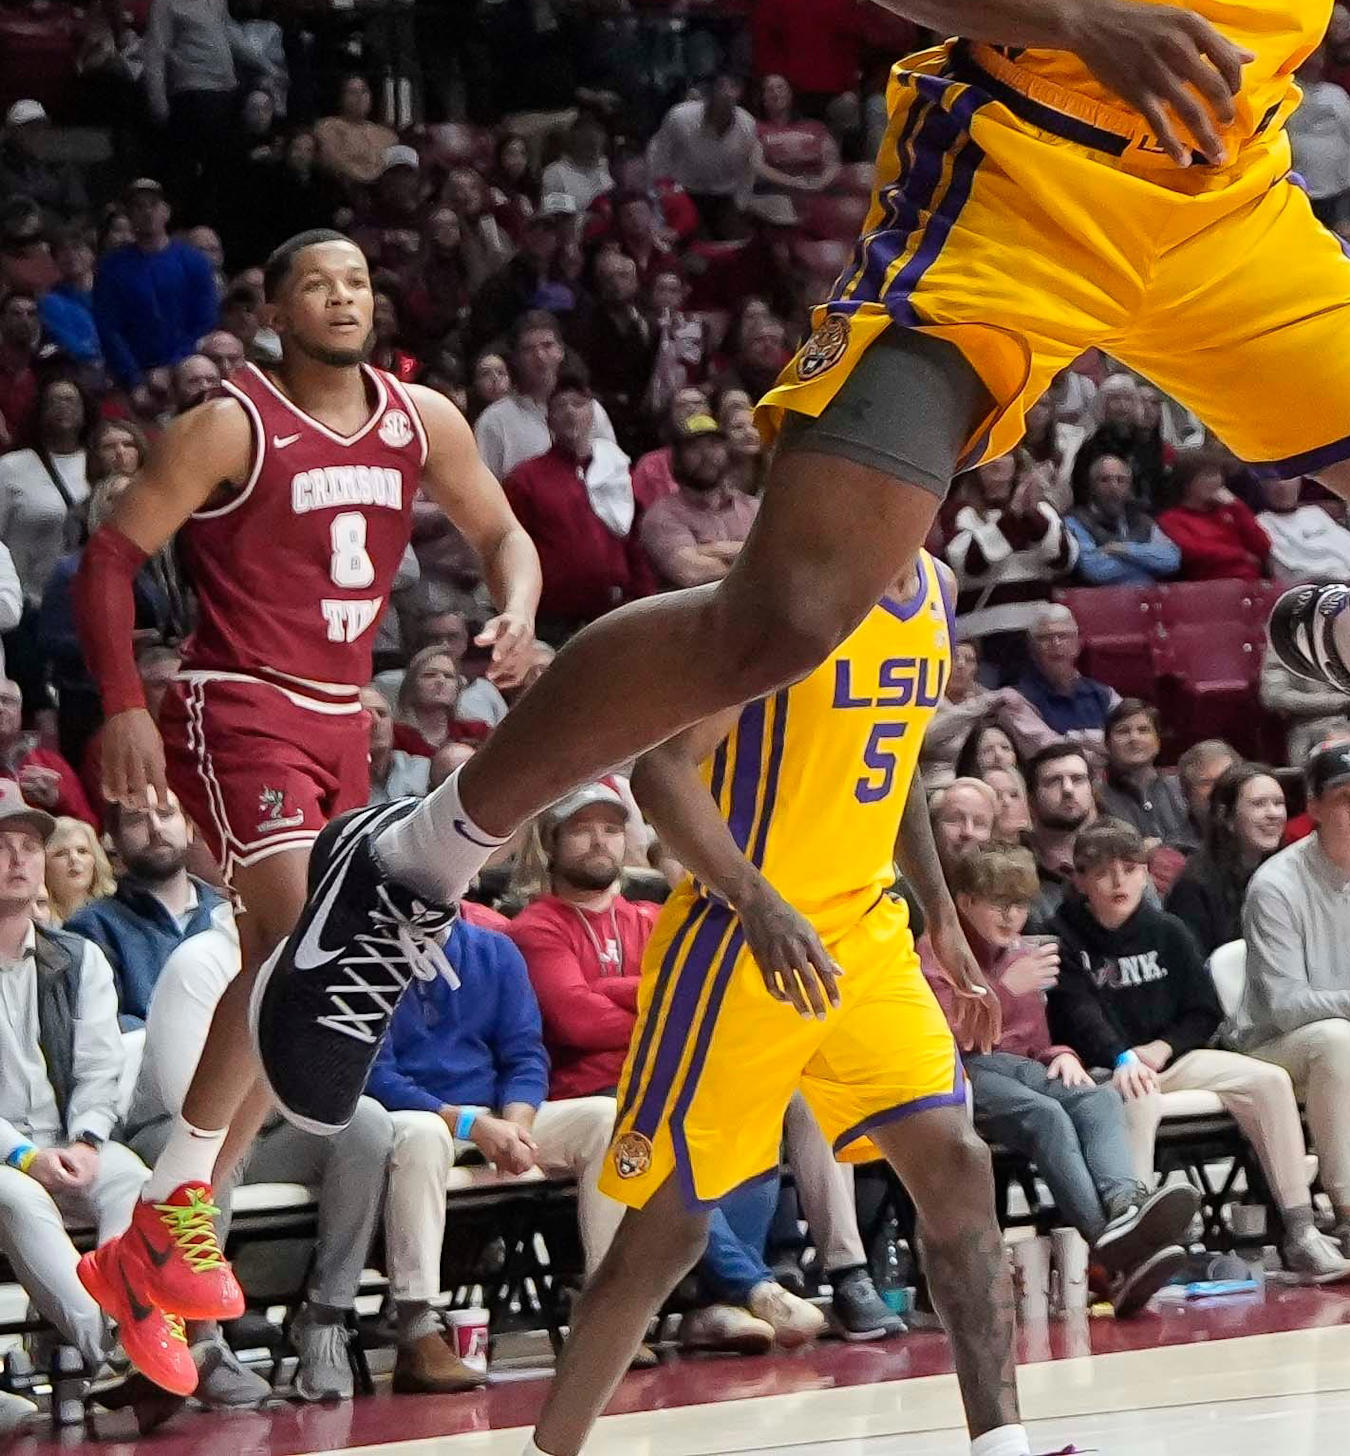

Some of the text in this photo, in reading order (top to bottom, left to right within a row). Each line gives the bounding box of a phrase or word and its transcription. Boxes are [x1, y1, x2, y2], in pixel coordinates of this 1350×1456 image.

[291, 464, 403, 514] CRIMSON
[330, 510, 376, 589] 8
[832, 657, 945, 709] LSU
[854, 722, 909, 804] 5
